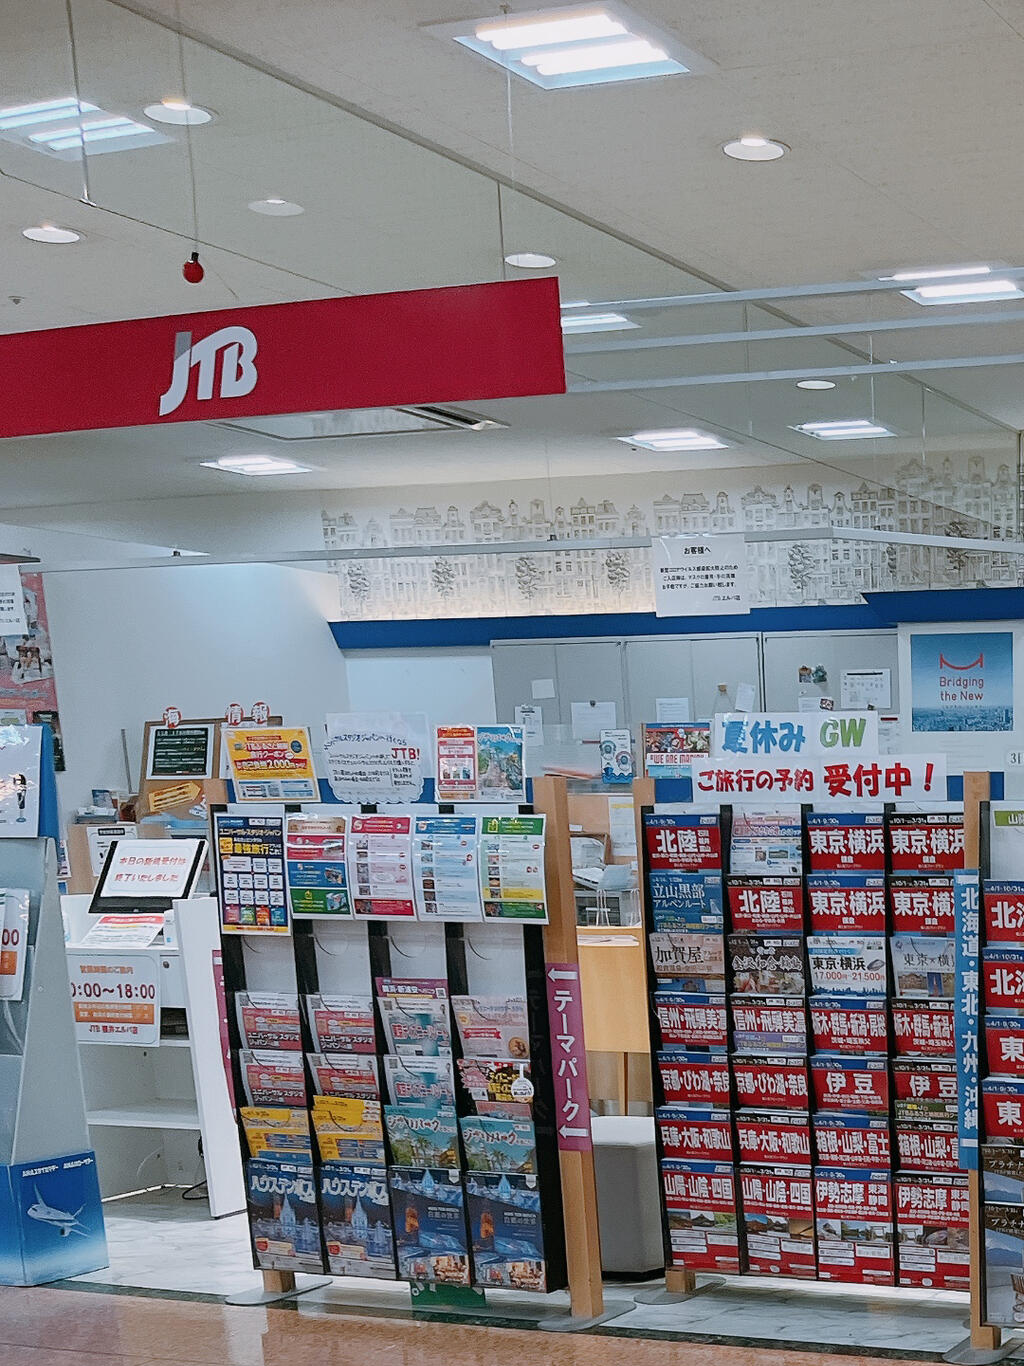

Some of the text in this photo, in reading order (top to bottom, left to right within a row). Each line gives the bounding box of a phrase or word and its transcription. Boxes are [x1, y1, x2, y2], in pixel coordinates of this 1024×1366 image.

[159, 326, 258, 416] JTB
[684, 546, 711, 555] お客様へ
[939, 676, 984, 689] Bridging
[940, 690, 983, 701] the New
[721, 718, 866, 754] 夏休み GW
[391, 747, 420, 761] JTB!
[698, 762, 934, 798] ご旅行の予約 受付中！
[656, 829, 698, 853] 北陸
[809, 829, 885, 854] 東京・横浜
[653, 883, 705, 899] 立山黒部
[739, 890, 781, 914] 北陸
[810, 891, 885, 917] 東京・横浜
[892, 891, 954, 917] 東京・横
[656, 946, 704, 964] 加賀屋
[812, 957, 867, 971] 東京・横浜
[553, 989, 580, 1122] テーマパーク
[825, 1071, 875, 1095] 伊豆
[909, 1075, 957, 1098] 伊豆
[816, 1180, 865, 1205] 伊勢志摩
[898, 1186, 948, 1211] 伊勢志摩
